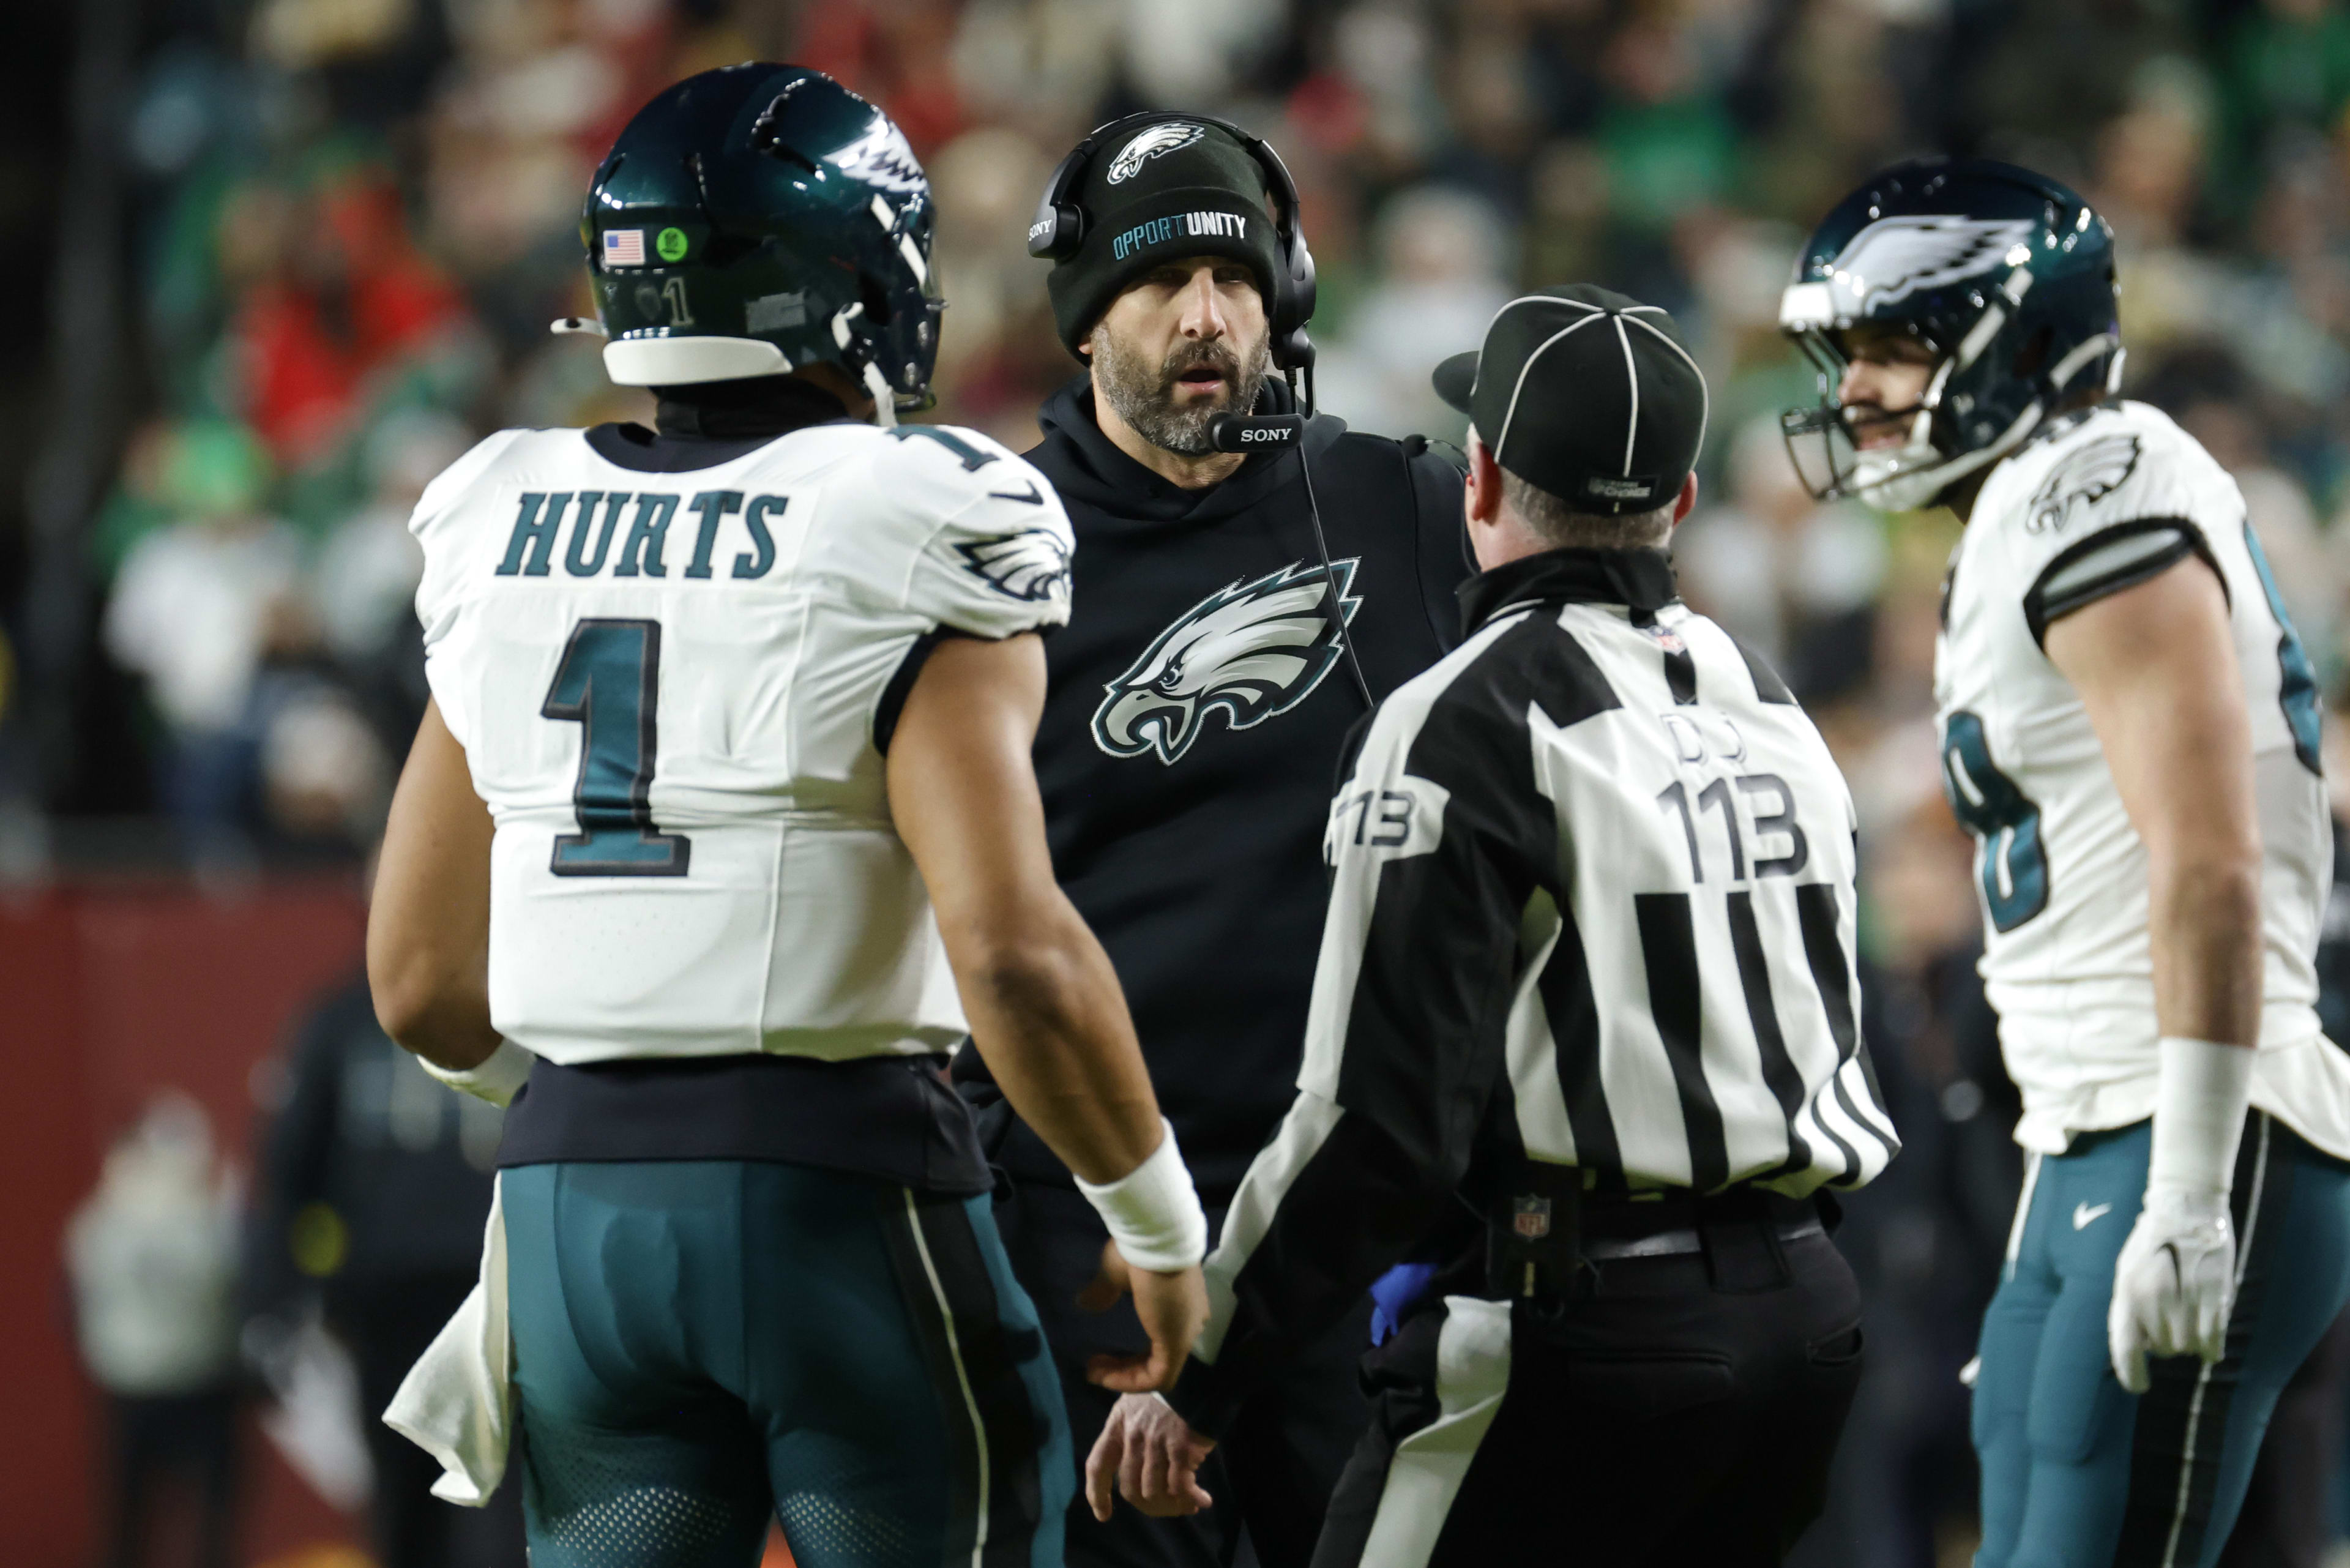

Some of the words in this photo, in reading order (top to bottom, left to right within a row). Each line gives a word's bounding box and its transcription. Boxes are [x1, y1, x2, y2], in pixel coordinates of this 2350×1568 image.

[1113, 212, 1246, 260] OPPORTUNITY
[662, 277, 695, 327] 1
[1240, 428, 1292, 442] SONY
[494, 490, 789, 580] HURTS
[540, 618, 691, 877] 1
[1656, 773, 1809, 884] 113
